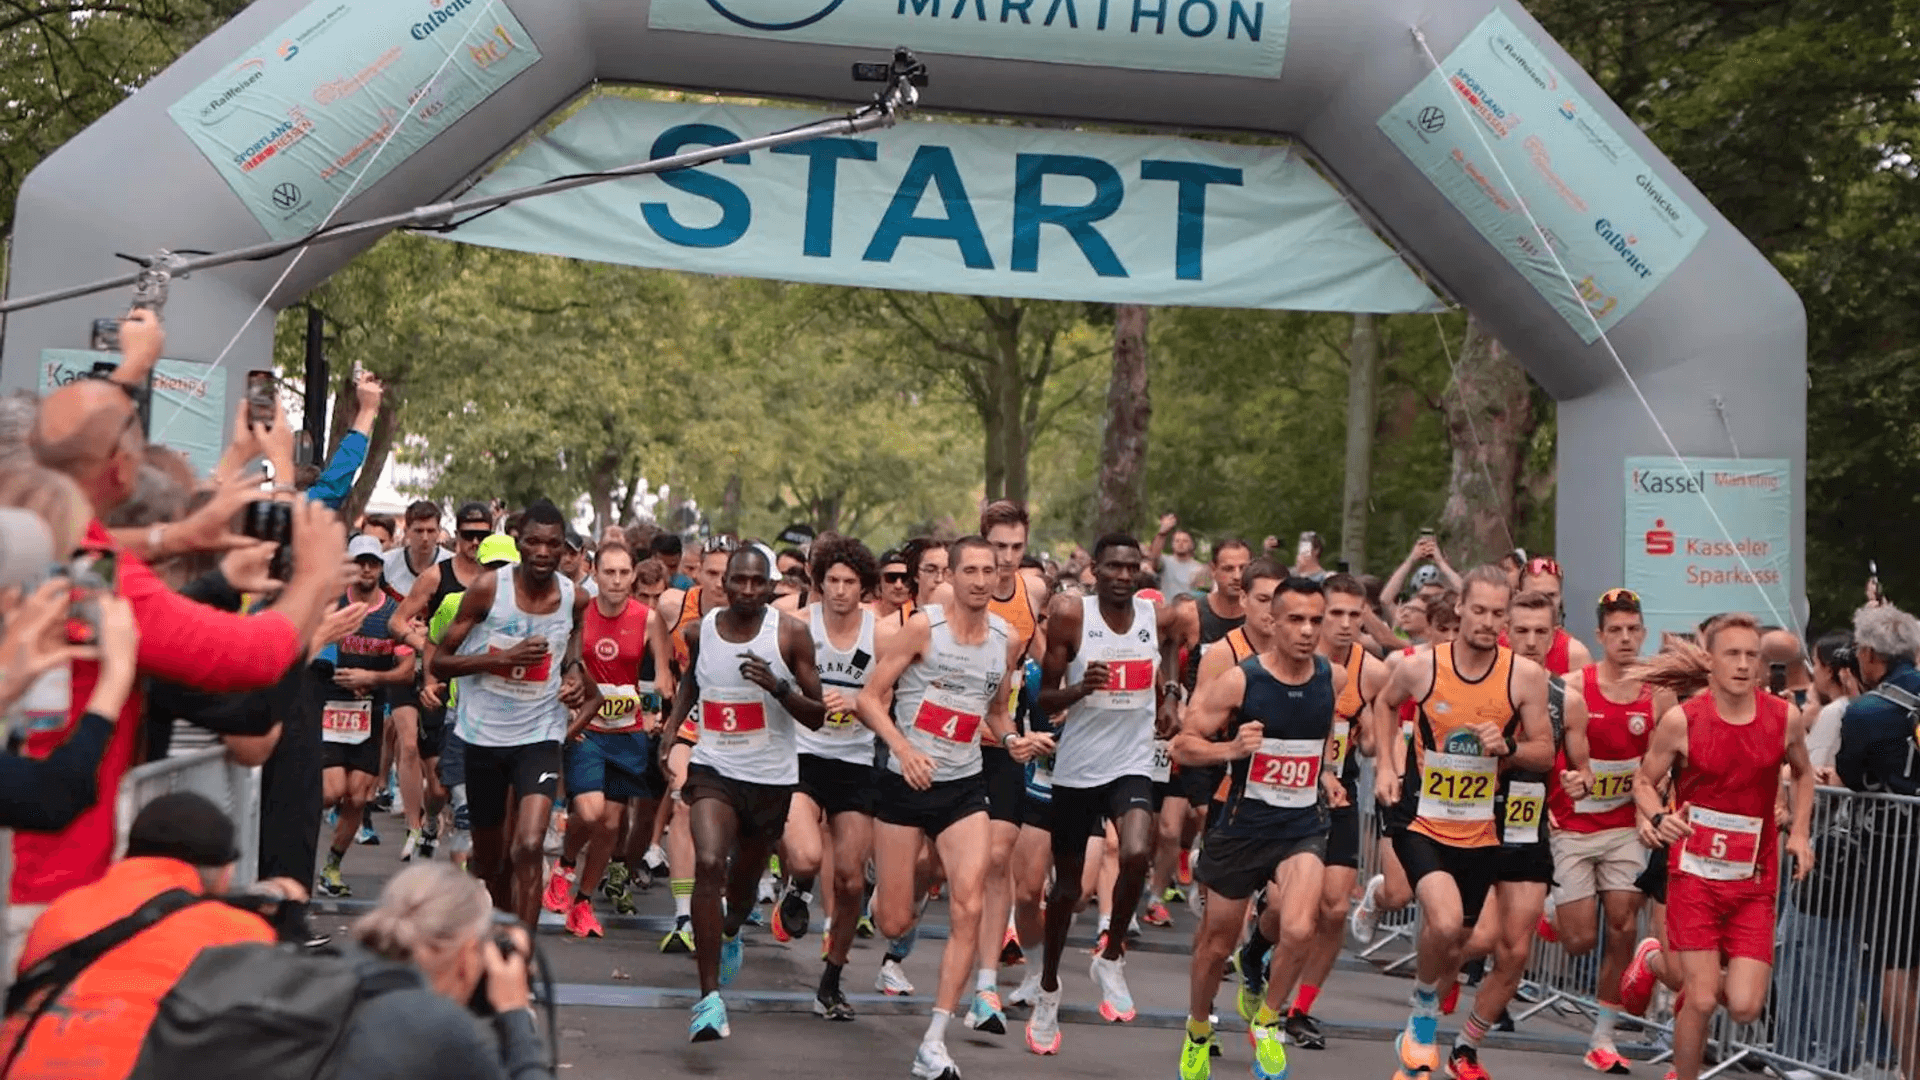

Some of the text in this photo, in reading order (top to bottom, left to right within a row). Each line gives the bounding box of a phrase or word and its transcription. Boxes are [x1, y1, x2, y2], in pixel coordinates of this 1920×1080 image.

[209, 70, 263, 111] Raiffeisen
[1457, 67, 1506, 119] SPORTLAND
[234, 120, 293, 165] SPORTLAND
[640, 122, 1243, 280] START
[1687, 538, 1769, 556] Kasseler
[1686, 564, 1780, 588] Sparkasse
[722, 707, 737, 731] 3
[941, 715, 958, 738] 4
[1449, 741, 1478, 754] EAM
[1263, 758, 1311, 787] 299
[1429, 772, 1488, 798] 2122
[1508, 800, 1536, 822] 26
[1710, 833, 1728, 858] 5
